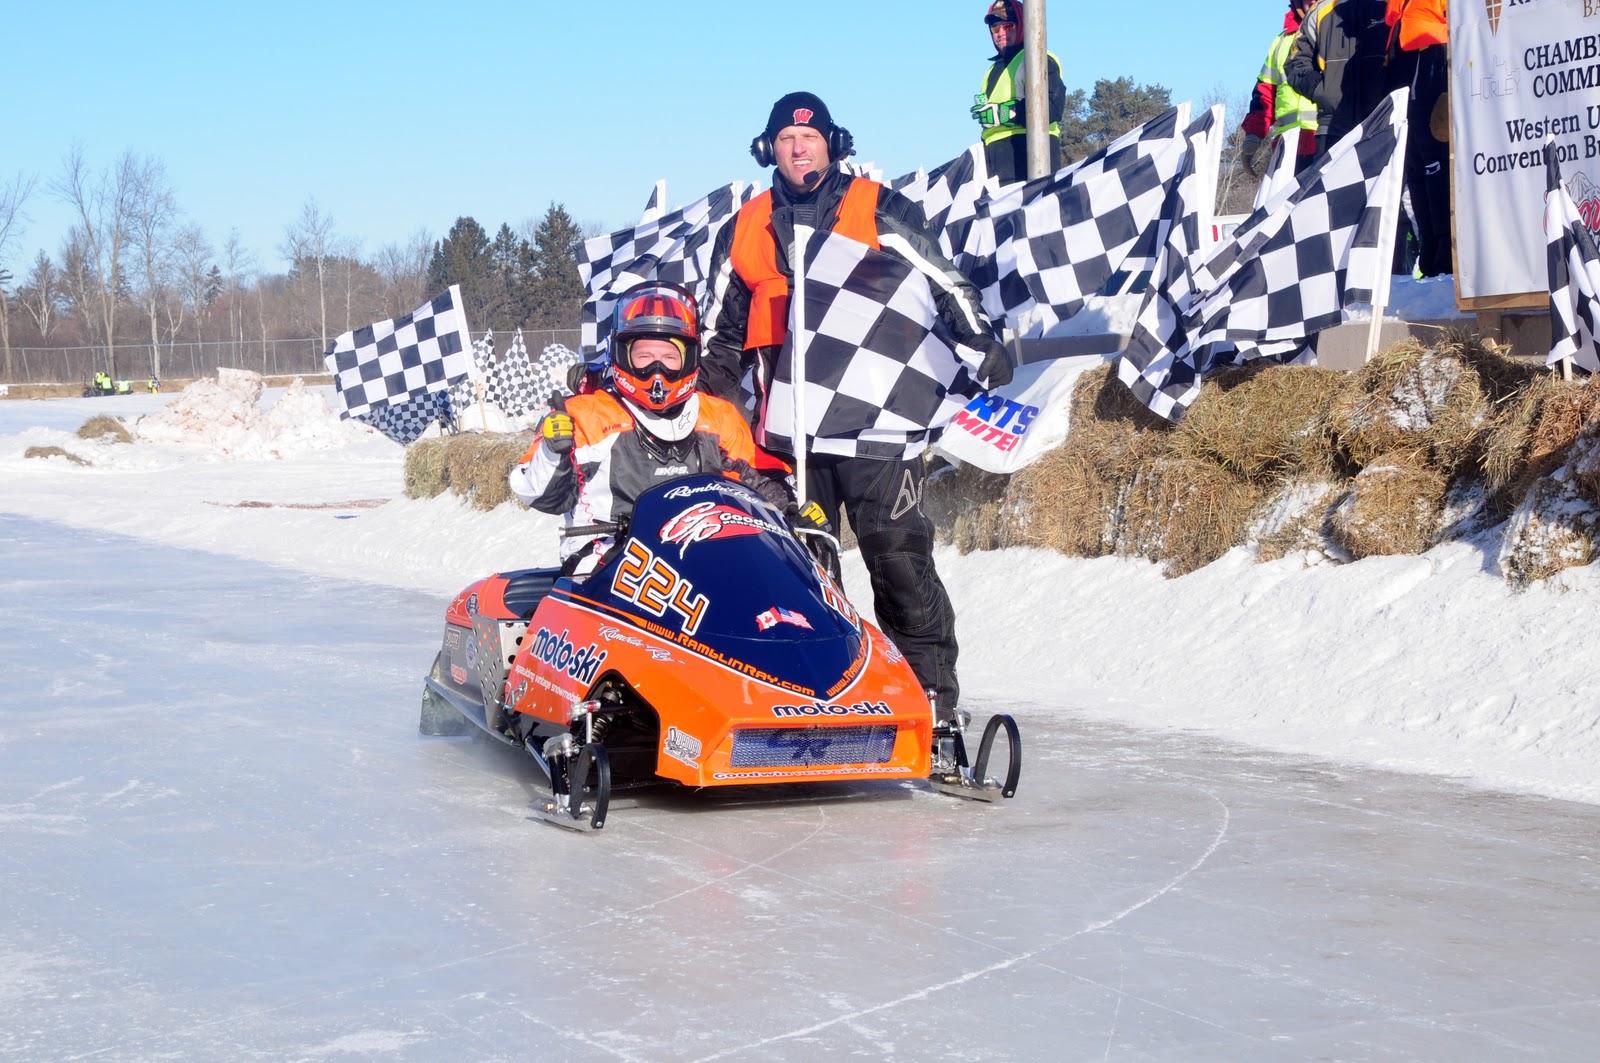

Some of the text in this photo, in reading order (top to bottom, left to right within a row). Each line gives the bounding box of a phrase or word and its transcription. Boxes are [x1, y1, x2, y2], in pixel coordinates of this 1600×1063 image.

[1524, 34, 1600, 71] CHAMB
[1470, 68, 1521, 102] HURLEY
[793, 108, 813, 125] W
[1506, 114, 1581, 143] Western
[1473, 143, 1579, 176] Conventon
[719, 512, 794, 538] Goodwin
[610, 536, 710, 636] 224
[530, 627, 608, 687] moto-ski
[772, 701, 894, 717] moto-ski
